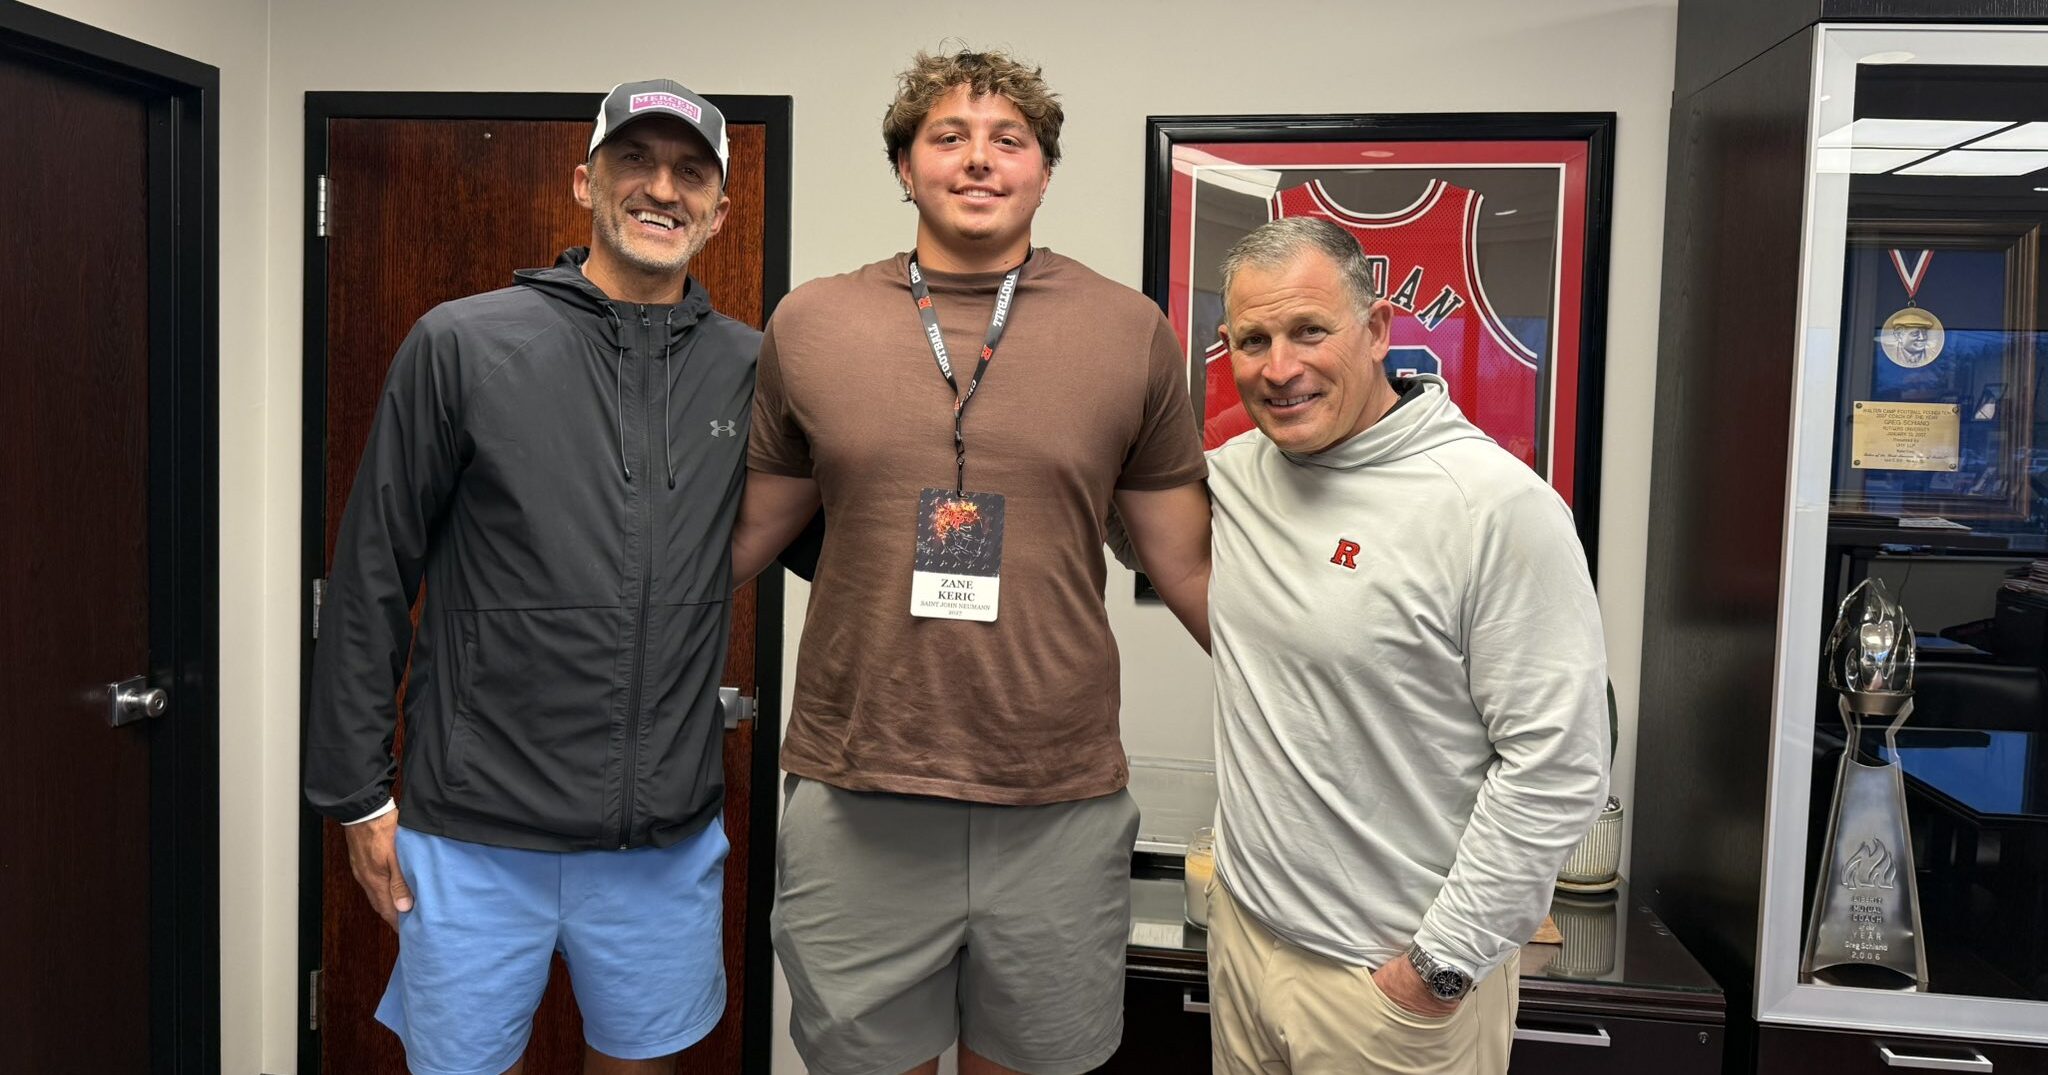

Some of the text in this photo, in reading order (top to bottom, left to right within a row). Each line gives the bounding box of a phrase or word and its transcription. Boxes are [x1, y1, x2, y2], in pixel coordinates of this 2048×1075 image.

[1365, 255, 1465, 332] DAN
[993, 274, 1017, 327] FOOTBALL
[928, 323, 953, 379] FOOTBALL
[1329, 538, 1361, 570] R
[941, 578, 974, 589] ZANE
[938, 590, 976, 602] KERIC
[920, 600, 990, 611] SAINT JOHN NEUMANN
[1852, 905, 1882, 914] MUTUAL
[1852, 914, 1883, 923] COACH
[1851, 931, 1882, 941] YEAR
[1844, 941, 1888, 951] Greg Schiano
[1851, 951, 1881, 961] 2006
